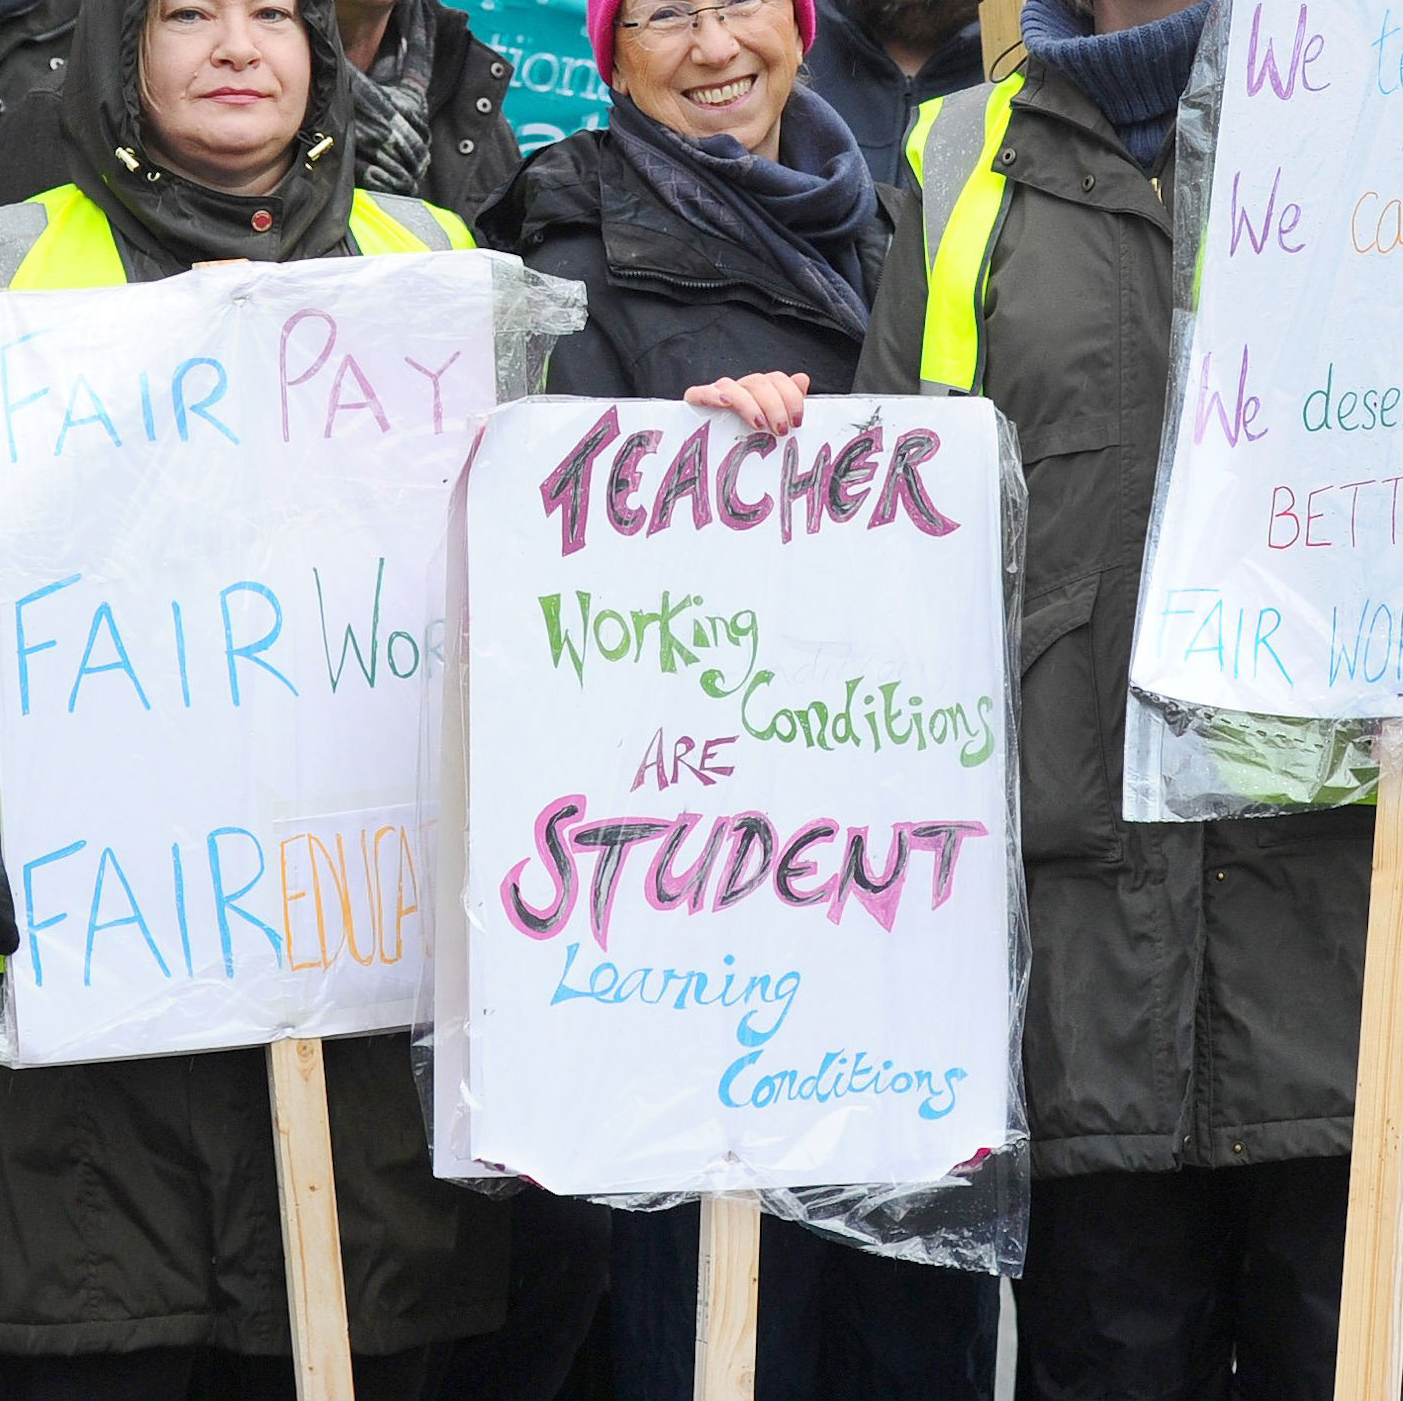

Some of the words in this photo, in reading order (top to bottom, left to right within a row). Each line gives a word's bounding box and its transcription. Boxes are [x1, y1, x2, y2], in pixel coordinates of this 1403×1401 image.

[1245, 2, 1332, 100] We
[1229, 167, 1307, 257] We
[1, 333, 241, 463] FAIR
[280, 308, 462, 442] PAY
[1191, 343, 1269, 449] We
[538, 404, 961, 558] TEACHER
[16, 572, 299, 715] FAIR
[538, 591, 759, 700] Working
[1153, 588, 1294, 688] FAIR
[631, 727, 740, 792] ARE
[741, 669, 995, 769] Conditions
[22, 825, 282, 987] FAIR
[500, 794, 990, 953] STUDENT
[550, 943, 801, 1047] Learning
[718, 1048, 970, 1120] Conditions
